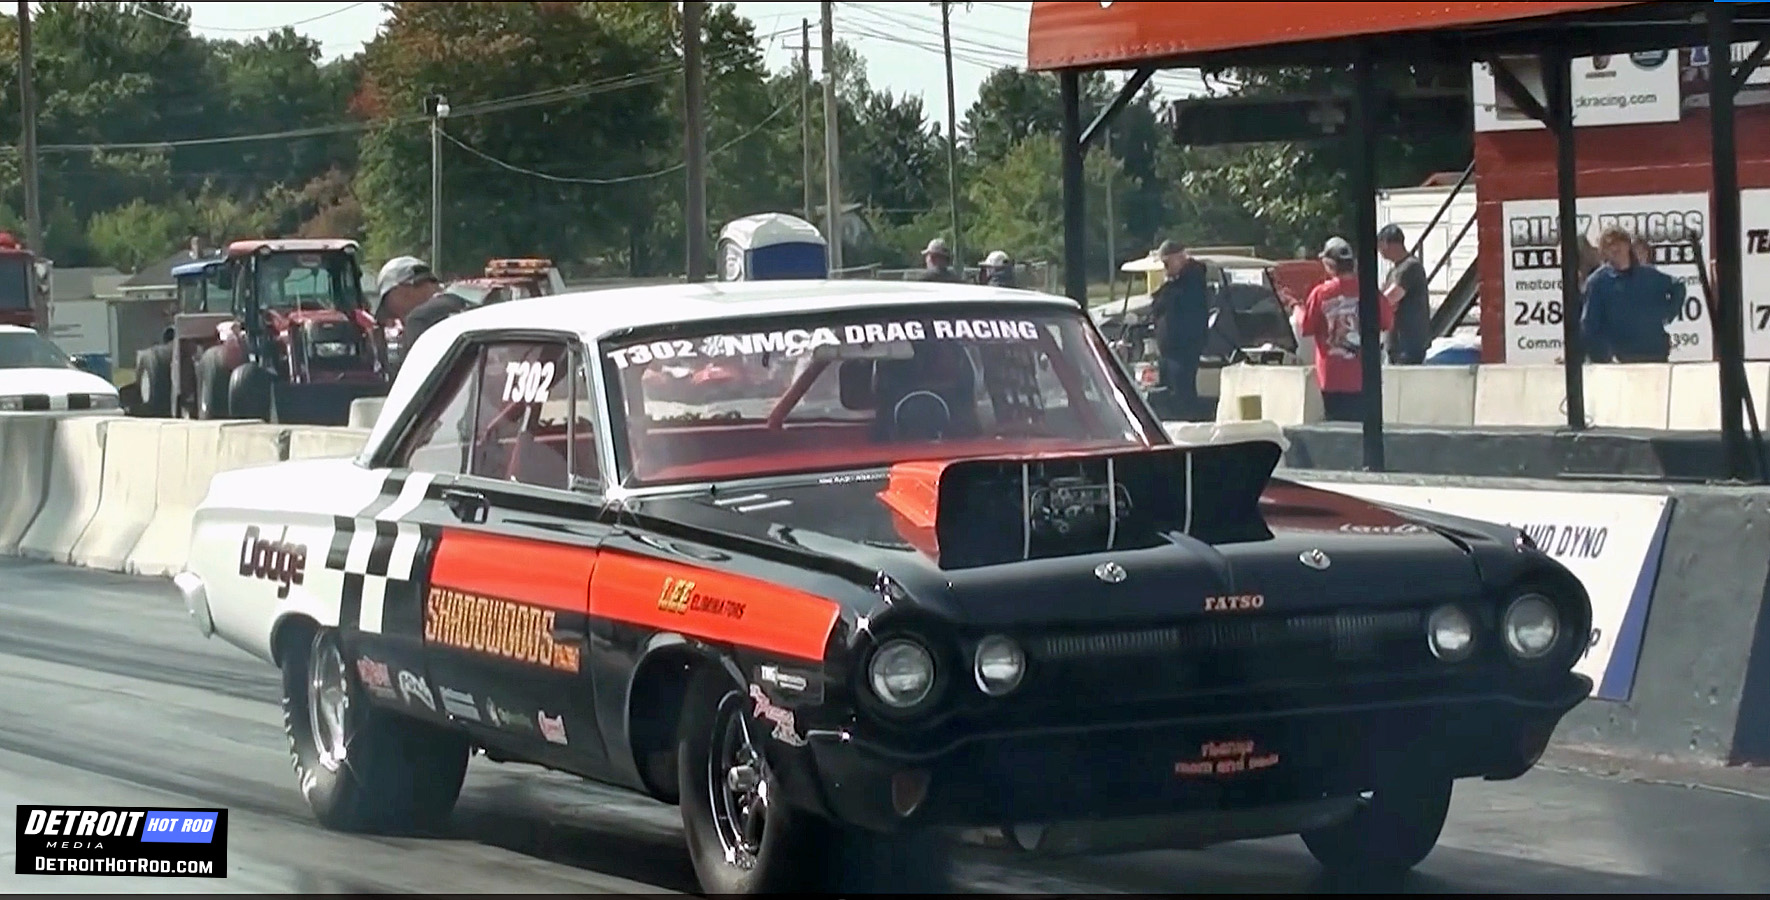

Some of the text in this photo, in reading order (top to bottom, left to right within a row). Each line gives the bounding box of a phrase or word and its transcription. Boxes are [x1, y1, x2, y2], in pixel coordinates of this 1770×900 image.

[1510, 214, 1592, 248] BILY
[607, 319, 1039, 369] T302 NMCA DRAG RACING
[502, 361, 555, 402] T302
[1520, 523, 1608, 559] WD DYNO
[239, 525, 307, 599] Dodge
[1204, 594, 1265, 611] FATSO
